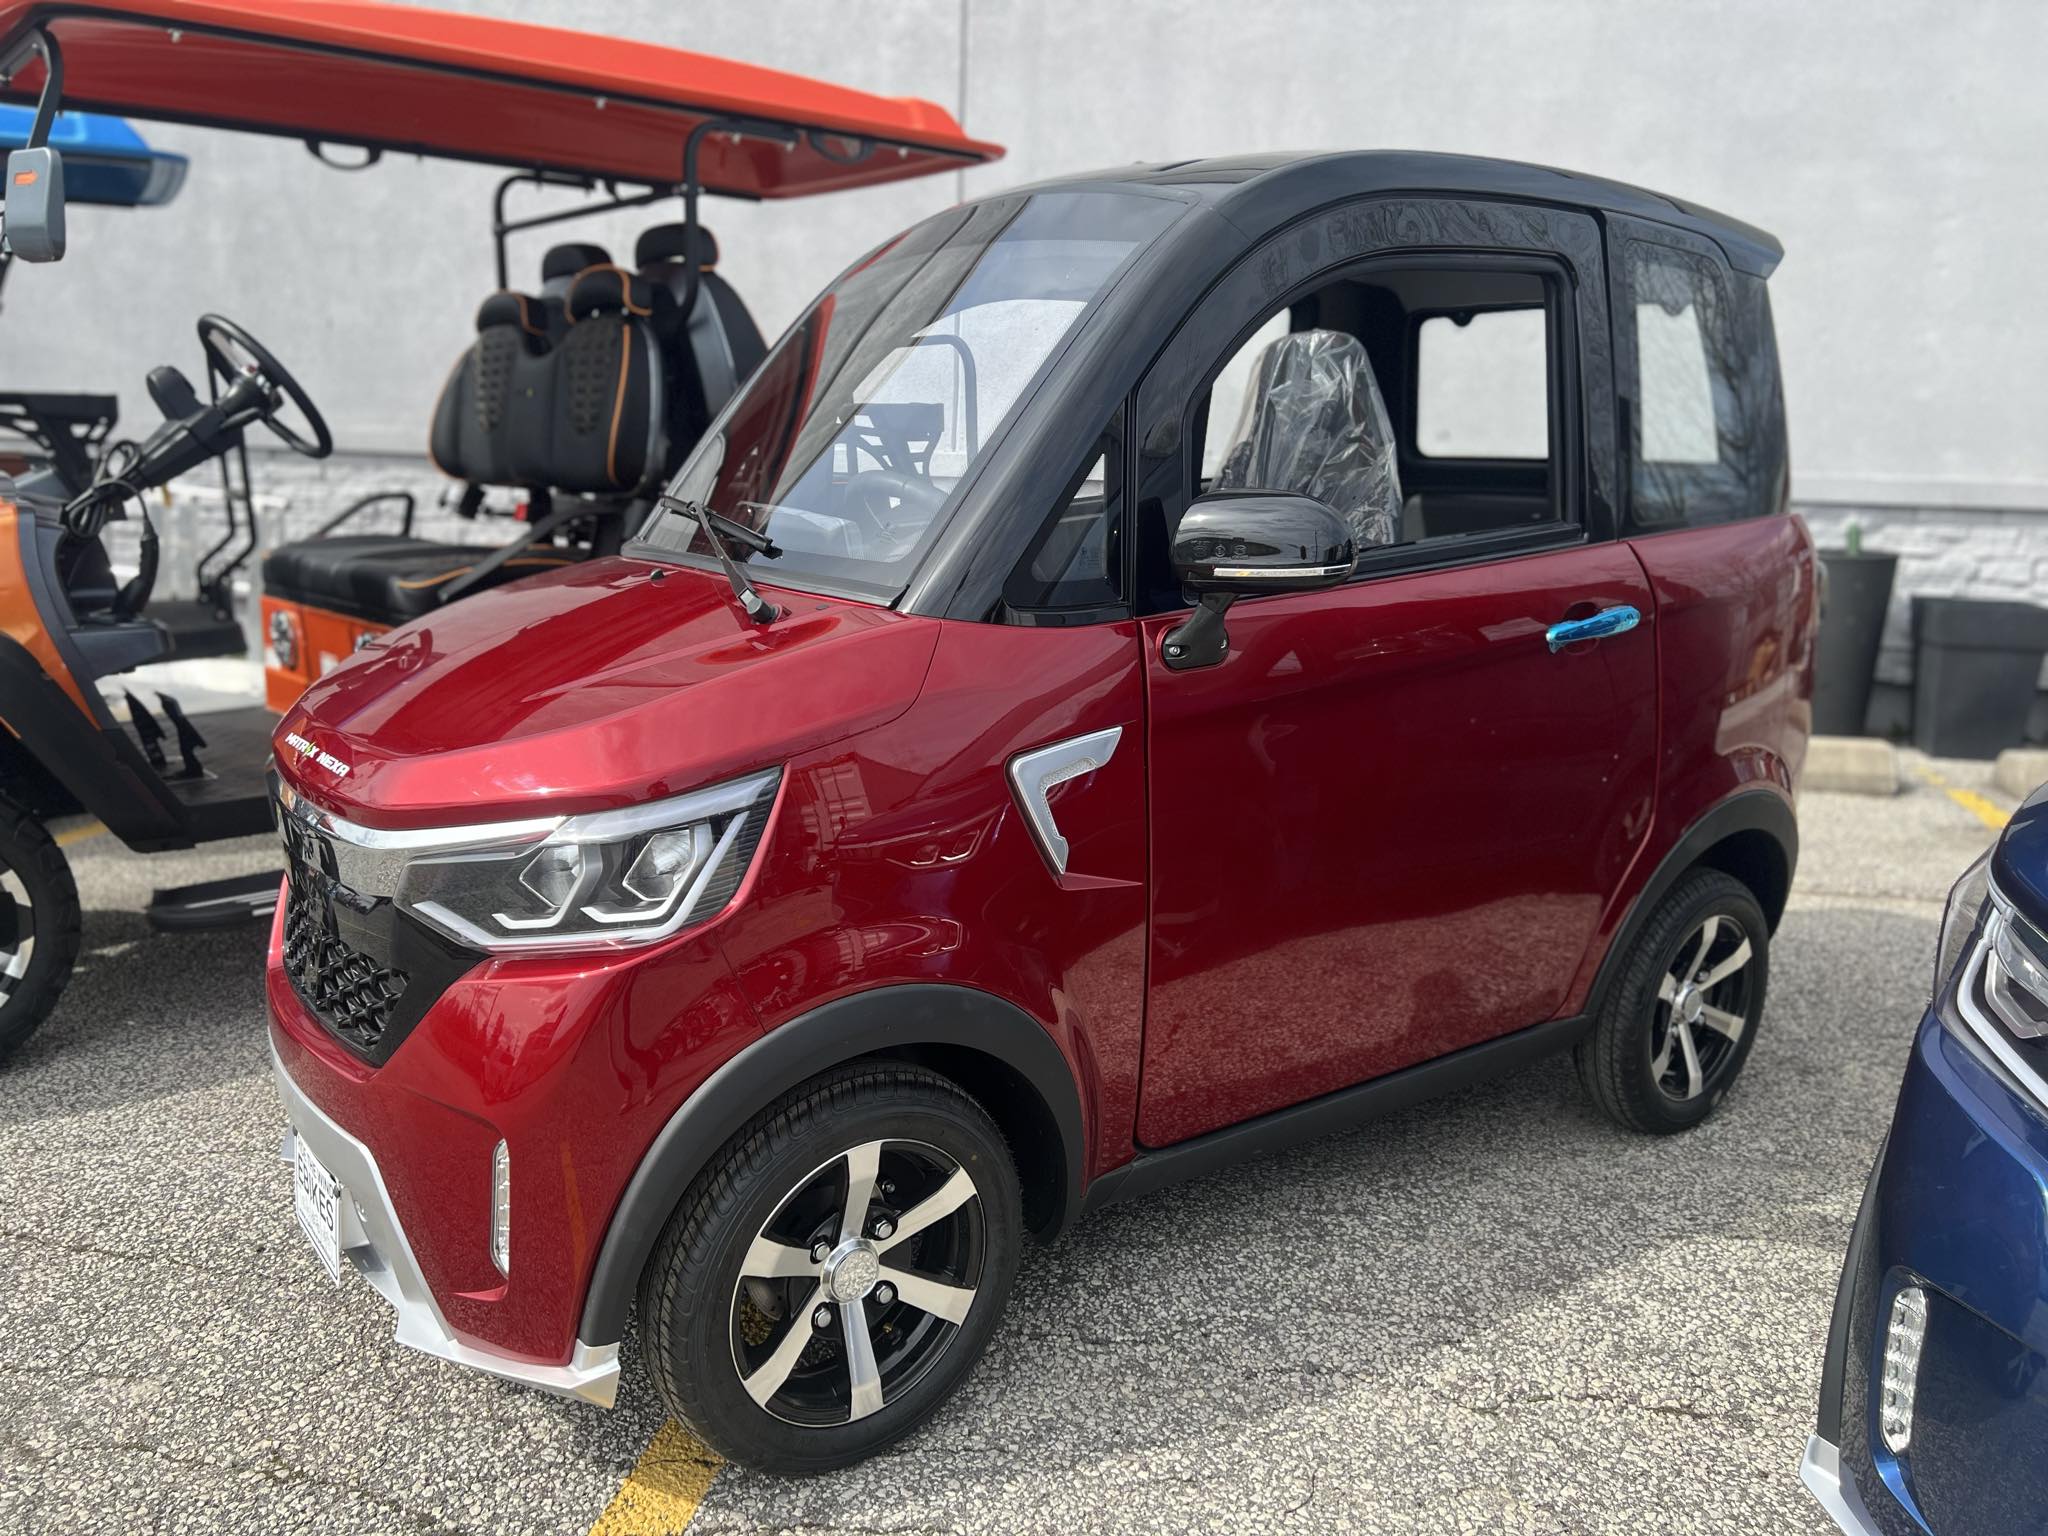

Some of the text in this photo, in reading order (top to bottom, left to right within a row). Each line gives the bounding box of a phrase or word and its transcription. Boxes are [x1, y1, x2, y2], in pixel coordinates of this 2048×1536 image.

[285, 732, 350, 777] MATRIX NEXA
[298, 1153, 334, 1232] EBIKES
